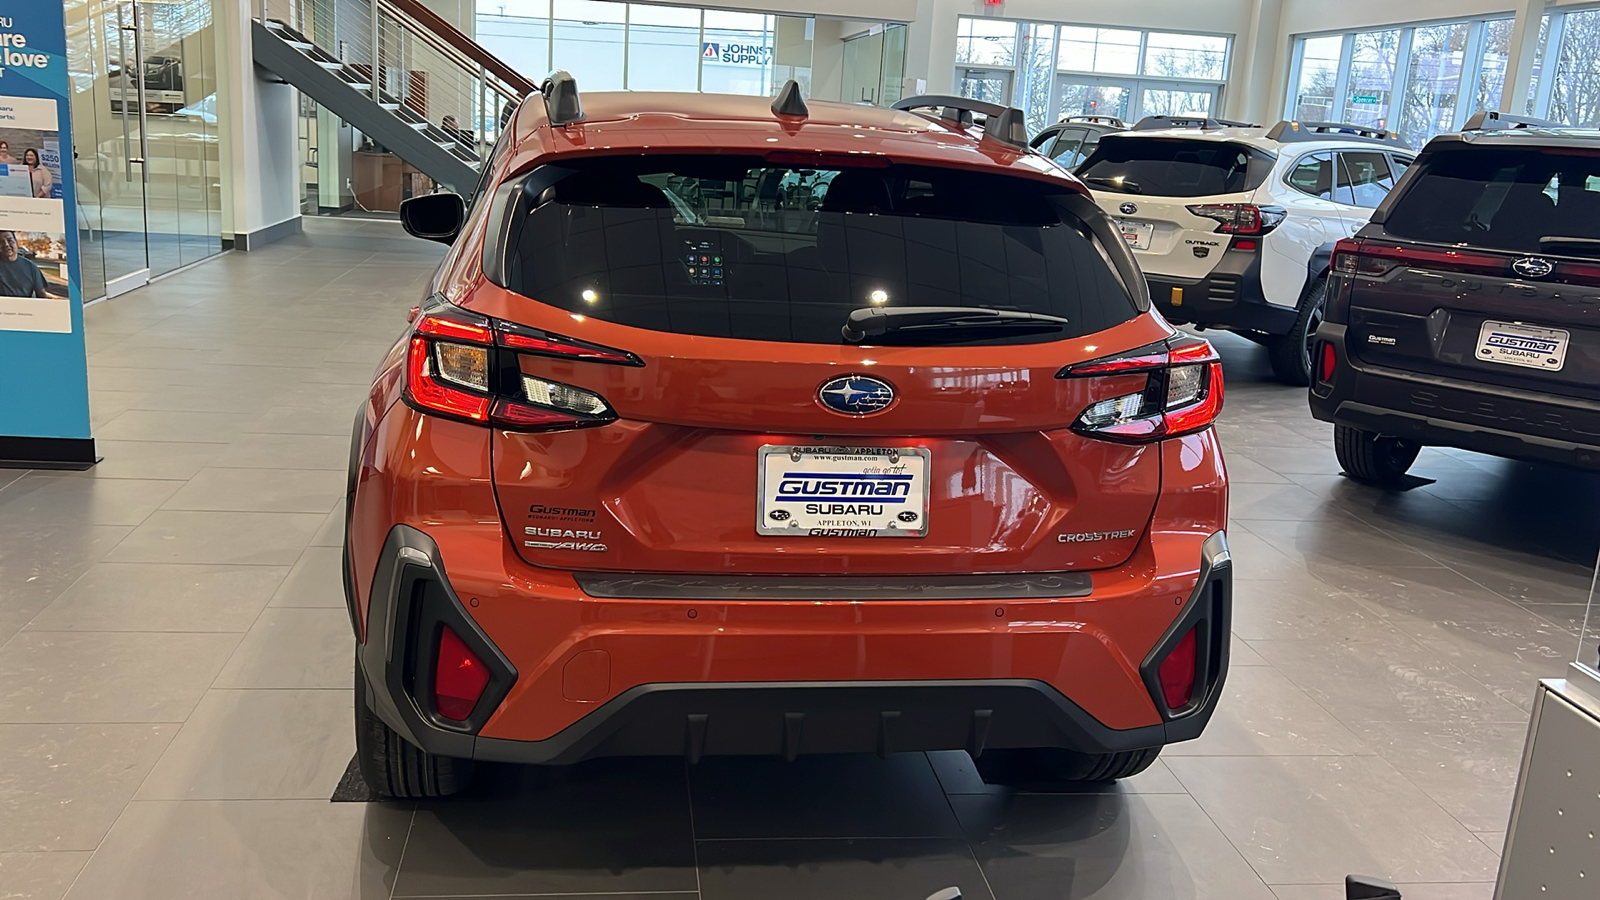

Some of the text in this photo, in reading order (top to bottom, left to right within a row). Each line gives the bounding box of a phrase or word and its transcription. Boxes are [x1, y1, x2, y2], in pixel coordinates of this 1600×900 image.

[0, 33, 26, 48] re
[722, 53, 771, 65] SUPPLY
[41, 154, 59, 163] $250
[1499, 348, 1540, 359] SUBARU
[792, 447, 899, 456] SUBARU APPLETON
[805, 503, 883, 516] SUBARU
[817, 519, 859, 527] APPLETON,
[524, 526, 602, 540] SUBARU
[1057, 529, 1136, 543] CROSSTREK
[555, 542, 608, 552] AWD
